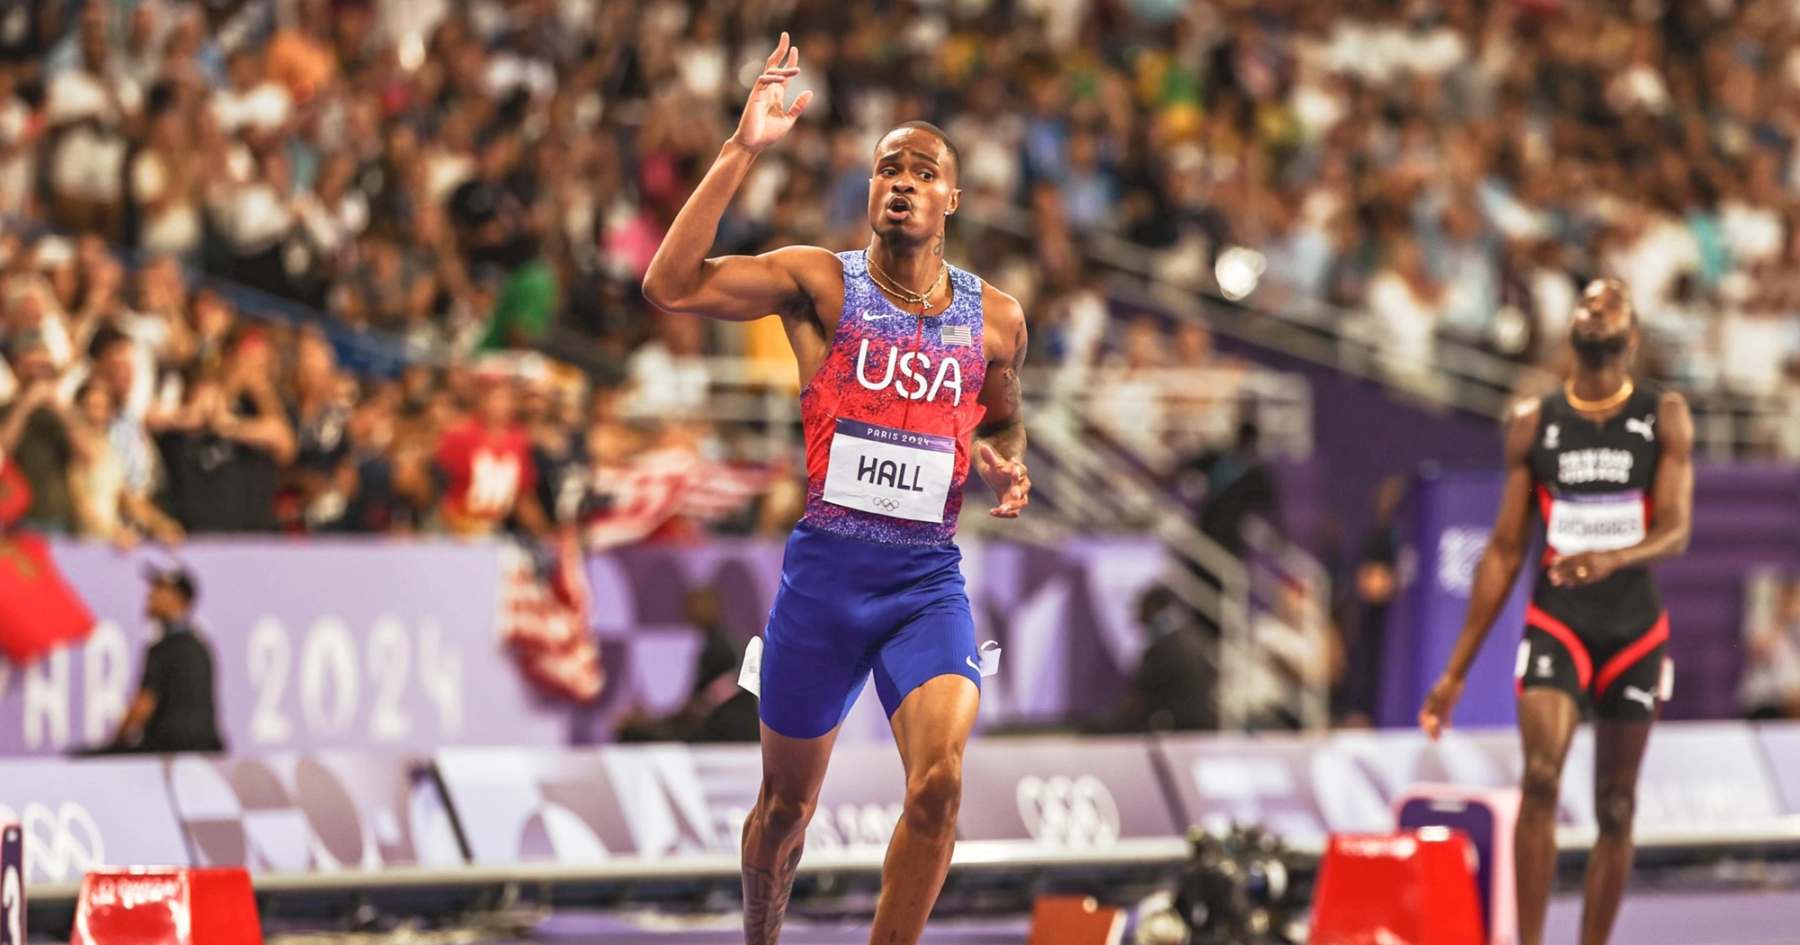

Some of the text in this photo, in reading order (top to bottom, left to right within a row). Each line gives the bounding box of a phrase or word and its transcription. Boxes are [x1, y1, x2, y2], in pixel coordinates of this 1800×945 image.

[856, 338, 961, 407] USA
[867, 428, 930, 446] PARIS 2024
[857, 455, 924, 492] HALL
[247, 613, 464, 744] 2024
